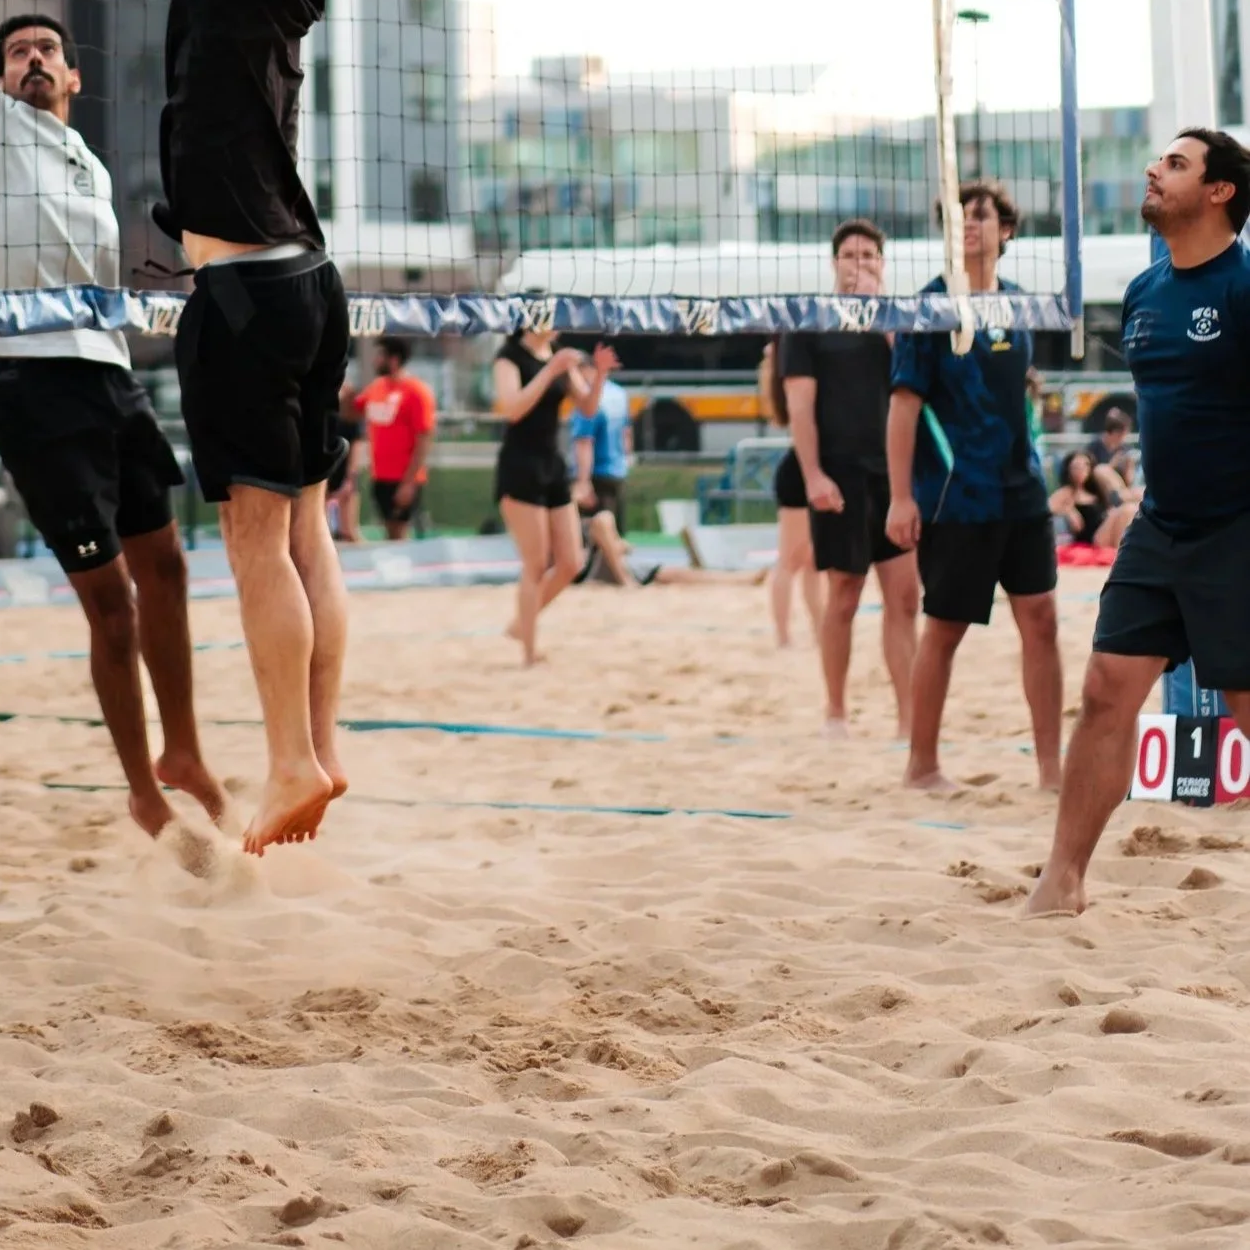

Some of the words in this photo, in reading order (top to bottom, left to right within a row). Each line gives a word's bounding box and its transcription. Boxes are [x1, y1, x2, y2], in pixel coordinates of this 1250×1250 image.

[1139, 727, 1169, 790] 0
[1190, 726, 1203, 759] 1
[1220, 727, 1250, 795] 0
